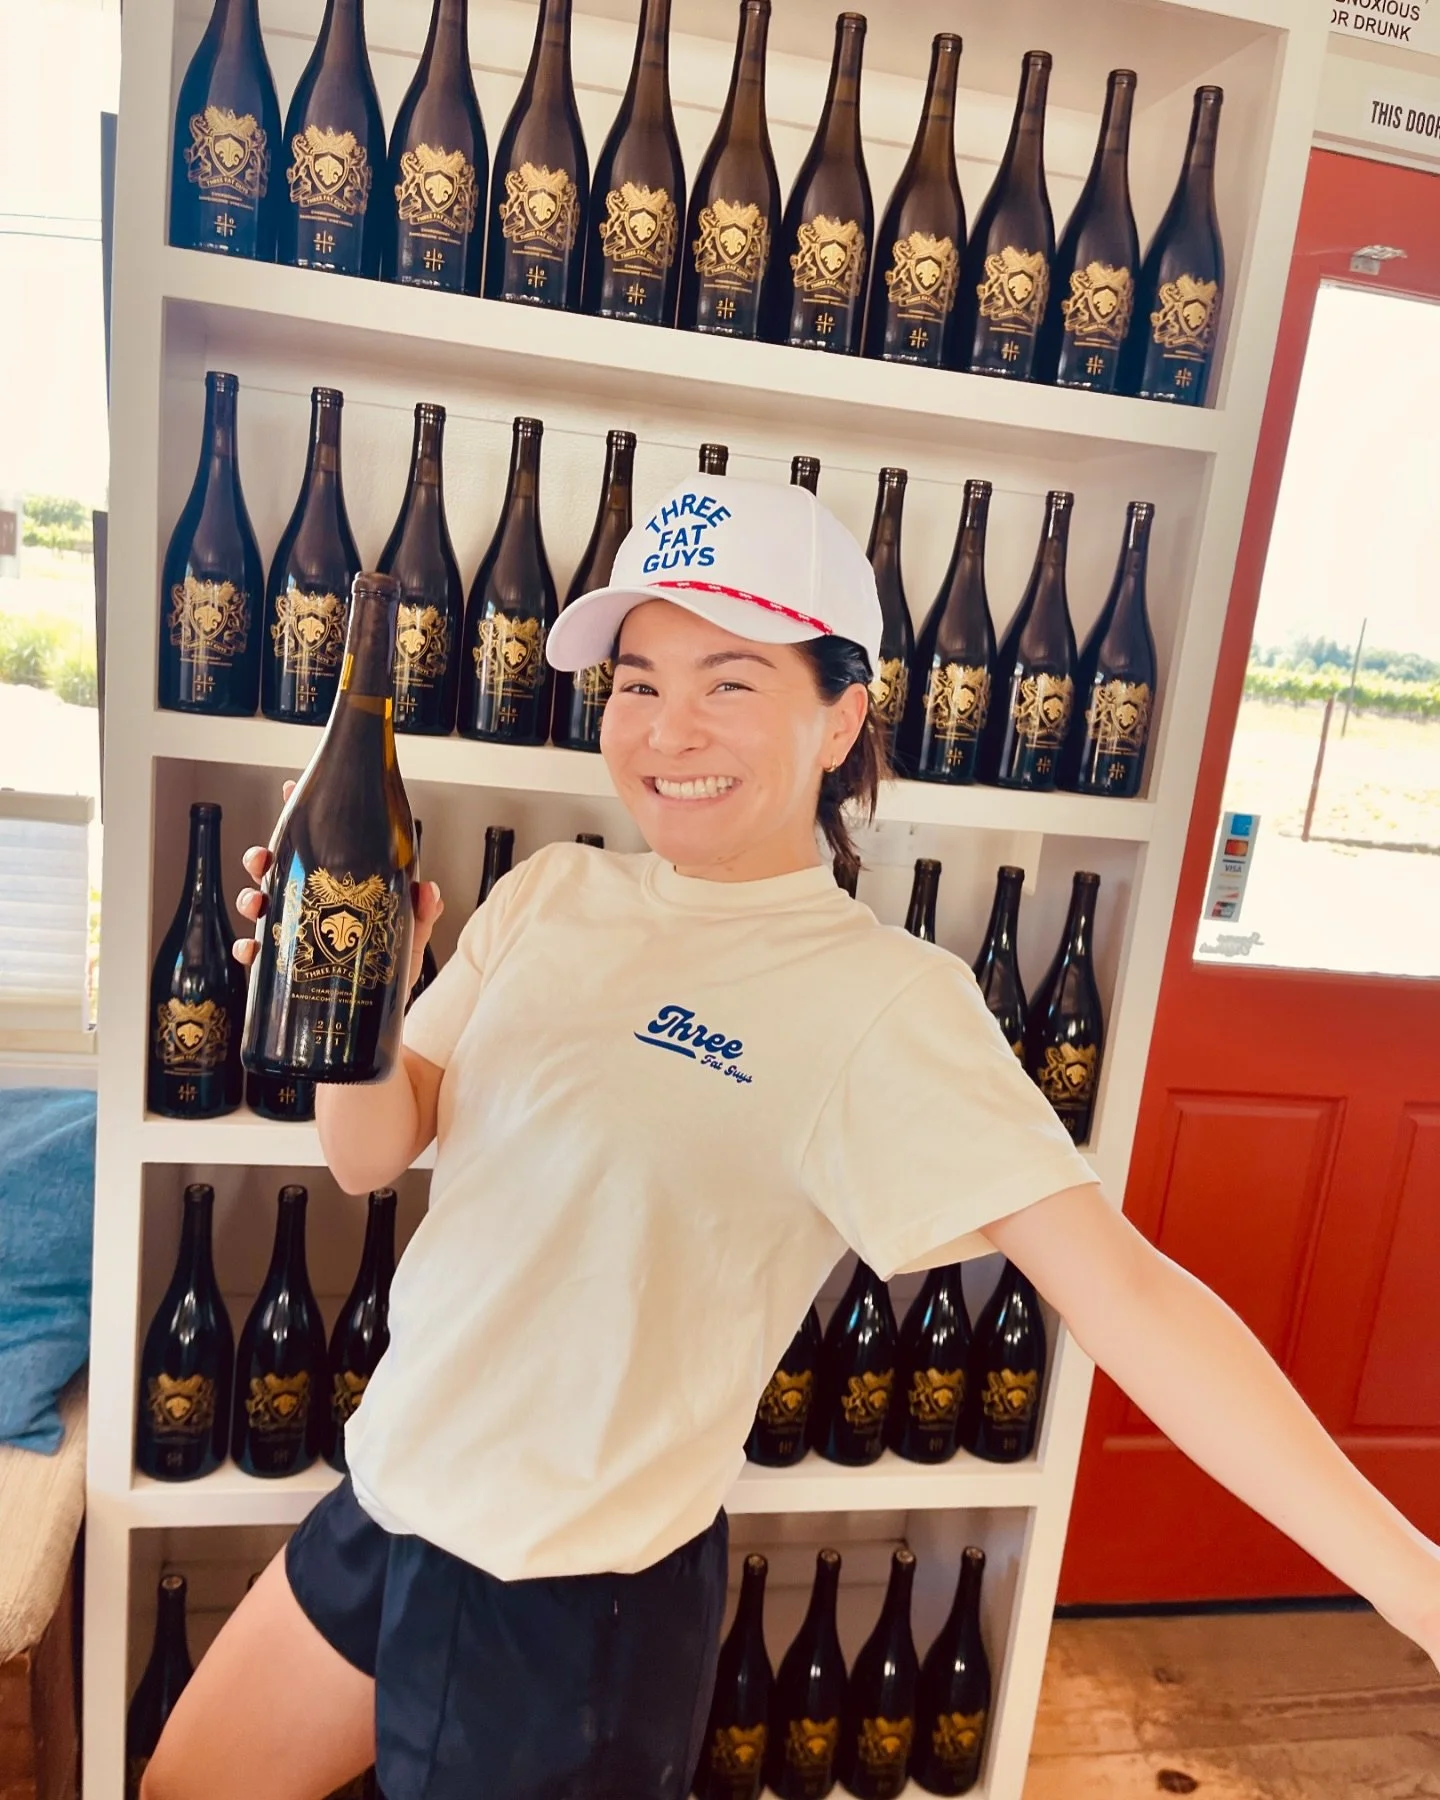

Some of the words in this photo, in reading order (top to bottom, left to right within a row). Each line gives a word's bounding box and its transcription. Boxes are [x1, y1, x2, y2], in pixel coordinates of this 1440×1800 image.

[1354, 15, 1411, 41] DRUNK
[1371, 100, 1402, 129] THIS
[645, 493, 732, 534] THREE
[659, 524, 708, 551] FAT
[643, 546, 715, 573] GUYS
[1224, 864, 1242, 873] VISA
[305, 967, 330, 979] THREE
[332, 966, 348, 975] FAT
[648, 1005, 743, 1059] Three
[700, 1054, 723, 1070] Fat
[724, 1065, 753, 1083] Guys
